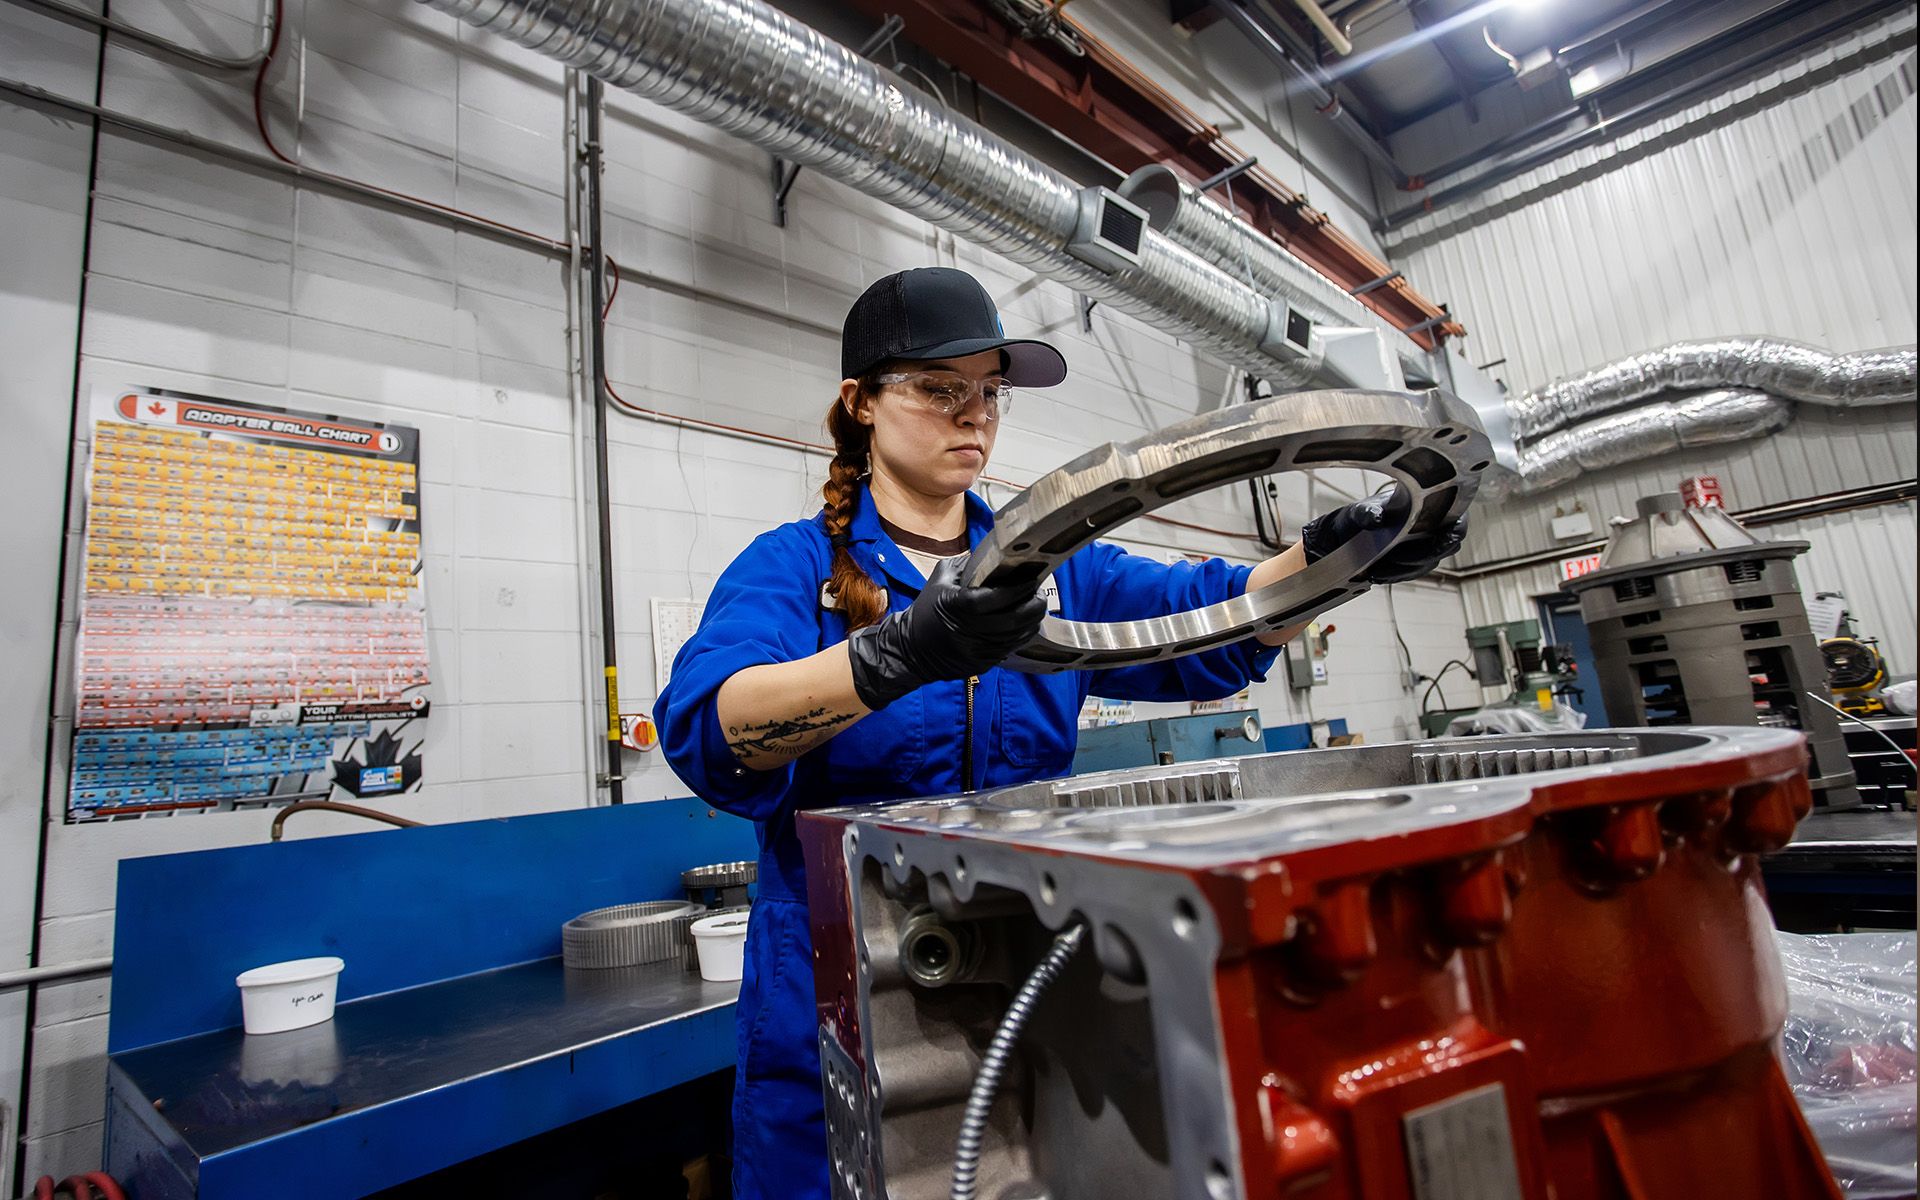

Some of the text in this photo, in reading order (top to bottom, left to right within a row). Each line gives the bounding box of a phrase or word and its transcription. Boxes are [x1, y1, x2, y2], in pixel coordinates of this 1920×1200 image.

[185, 408, 270, 431] ADAPTER
[318, 428, 372, 445] CHART
[385, 436, 393, 448] 1
[1565, 555, 1602, 581] EXIT
[304, 706, 337, 715] YOUR
